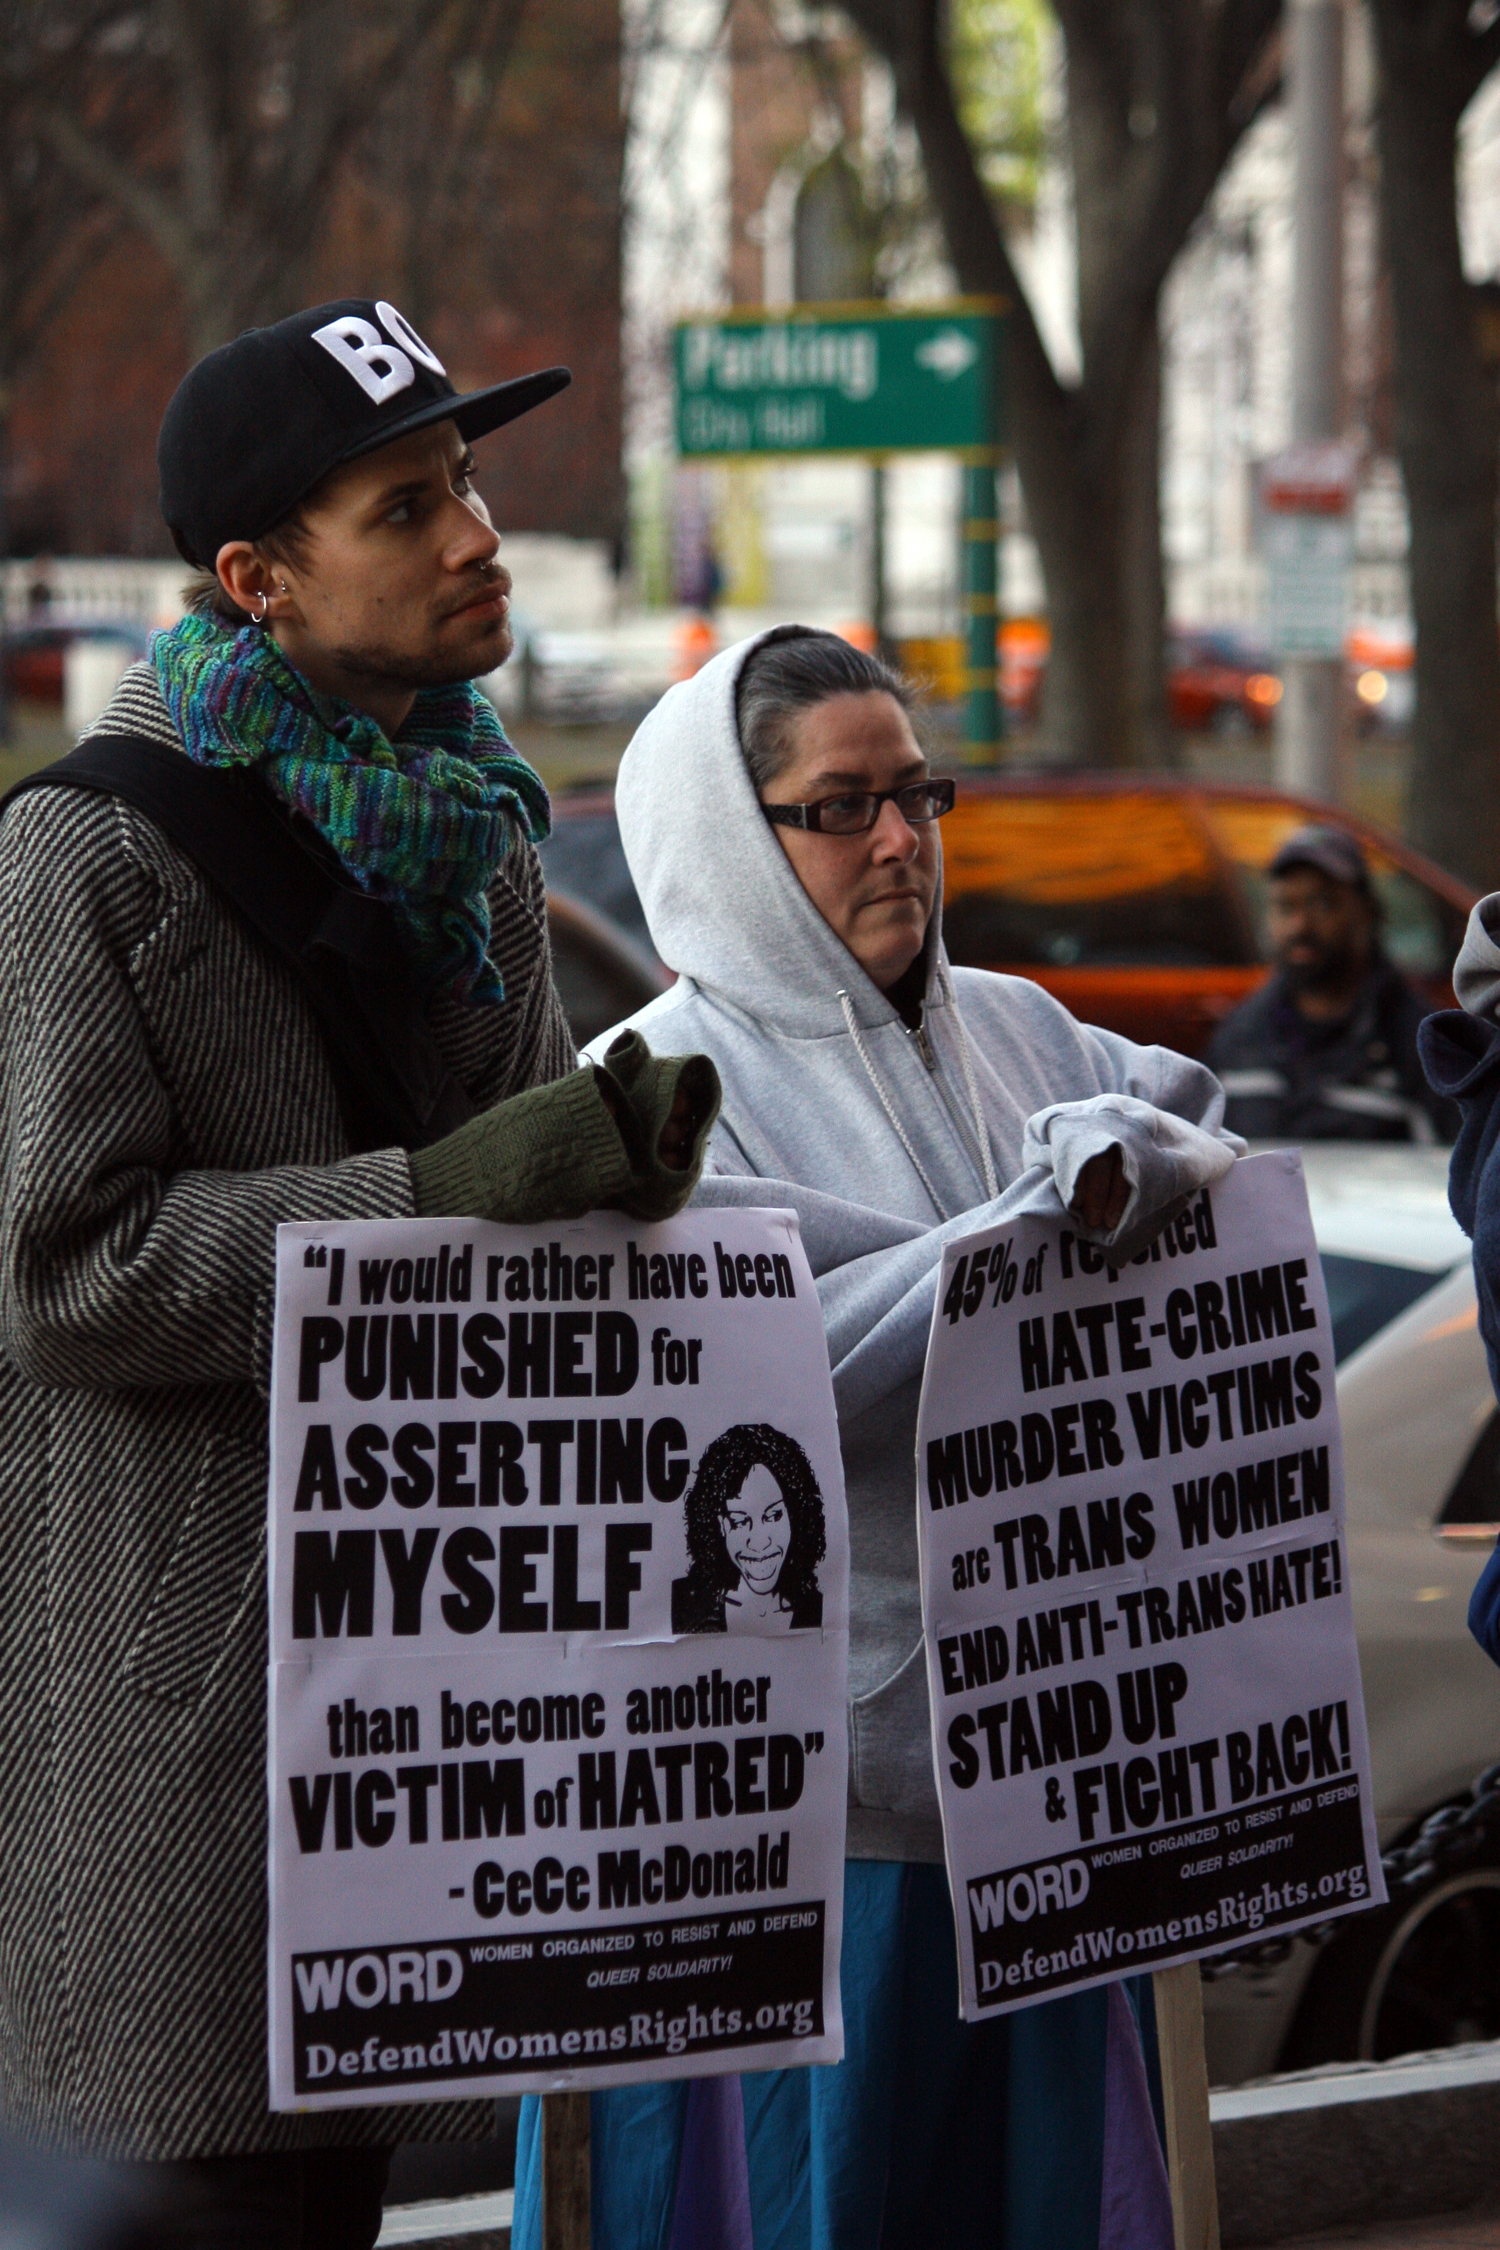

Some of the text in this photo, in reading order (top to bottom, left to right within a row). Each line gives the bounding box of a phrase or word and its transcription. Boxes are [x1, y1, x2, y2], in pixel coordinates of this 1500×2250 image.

[682, 324, 878, 402] Parking
[359, 1244, 473, 1305] would
[486, 1242, 614, 1302] rather
[627, 1241, 707, 1300] have
[714, 1242, 796, 1298] been
[942, 1238, 1018, 1325] 45%
[1022, 1243, 1048, 1296] of
[298, 1311, 702, 1402] PUNISHED for
[1018, 1258, 1317, 1393] HATE-CRIME
[294, 1417, 690, 1512] ASSERTING
[926, 1351, 1322, 1511] MURDER VICTIMS
[951, 1445, 1330, 1592] are TRANS WOMEN
[293, 1523, 652, 1639] MYSELF
[938, 1539, 1343, 1696] END ANTI-TRANS HATE!
[328, 1669, 771, 1758] than become another
[947, 1661, 1188, 1789] STAND UP
[289, 1758, 525, 1854] VICTIM
[534, 1777, 574, 1828] of
[1044, 1700, 1352, 1842] & FIGHT BACK!
[1091, 1783, 1359, 1868] WOMEN ORGANIZED TO RESIST AND DEFEND
[1180, 1834, 1294, 1879] QUEER SOLIDARITY!
[598, 1831, 789, 1910] McDonald
[969, 1858, 1089, 1933] WORD
[470, 1912, 817, 1963] WOMEN ORGANIZED TO RESIST AND DEFEND
[587, 1955, 733, 1988] QUEER SOLIDARITY!
[980, 1865, 1367, 1993] DefendWomensRights.org
[295, 1949, 463, 2013] WORD
[306, 2000, 814, 2078] DefendWomensRights.org
